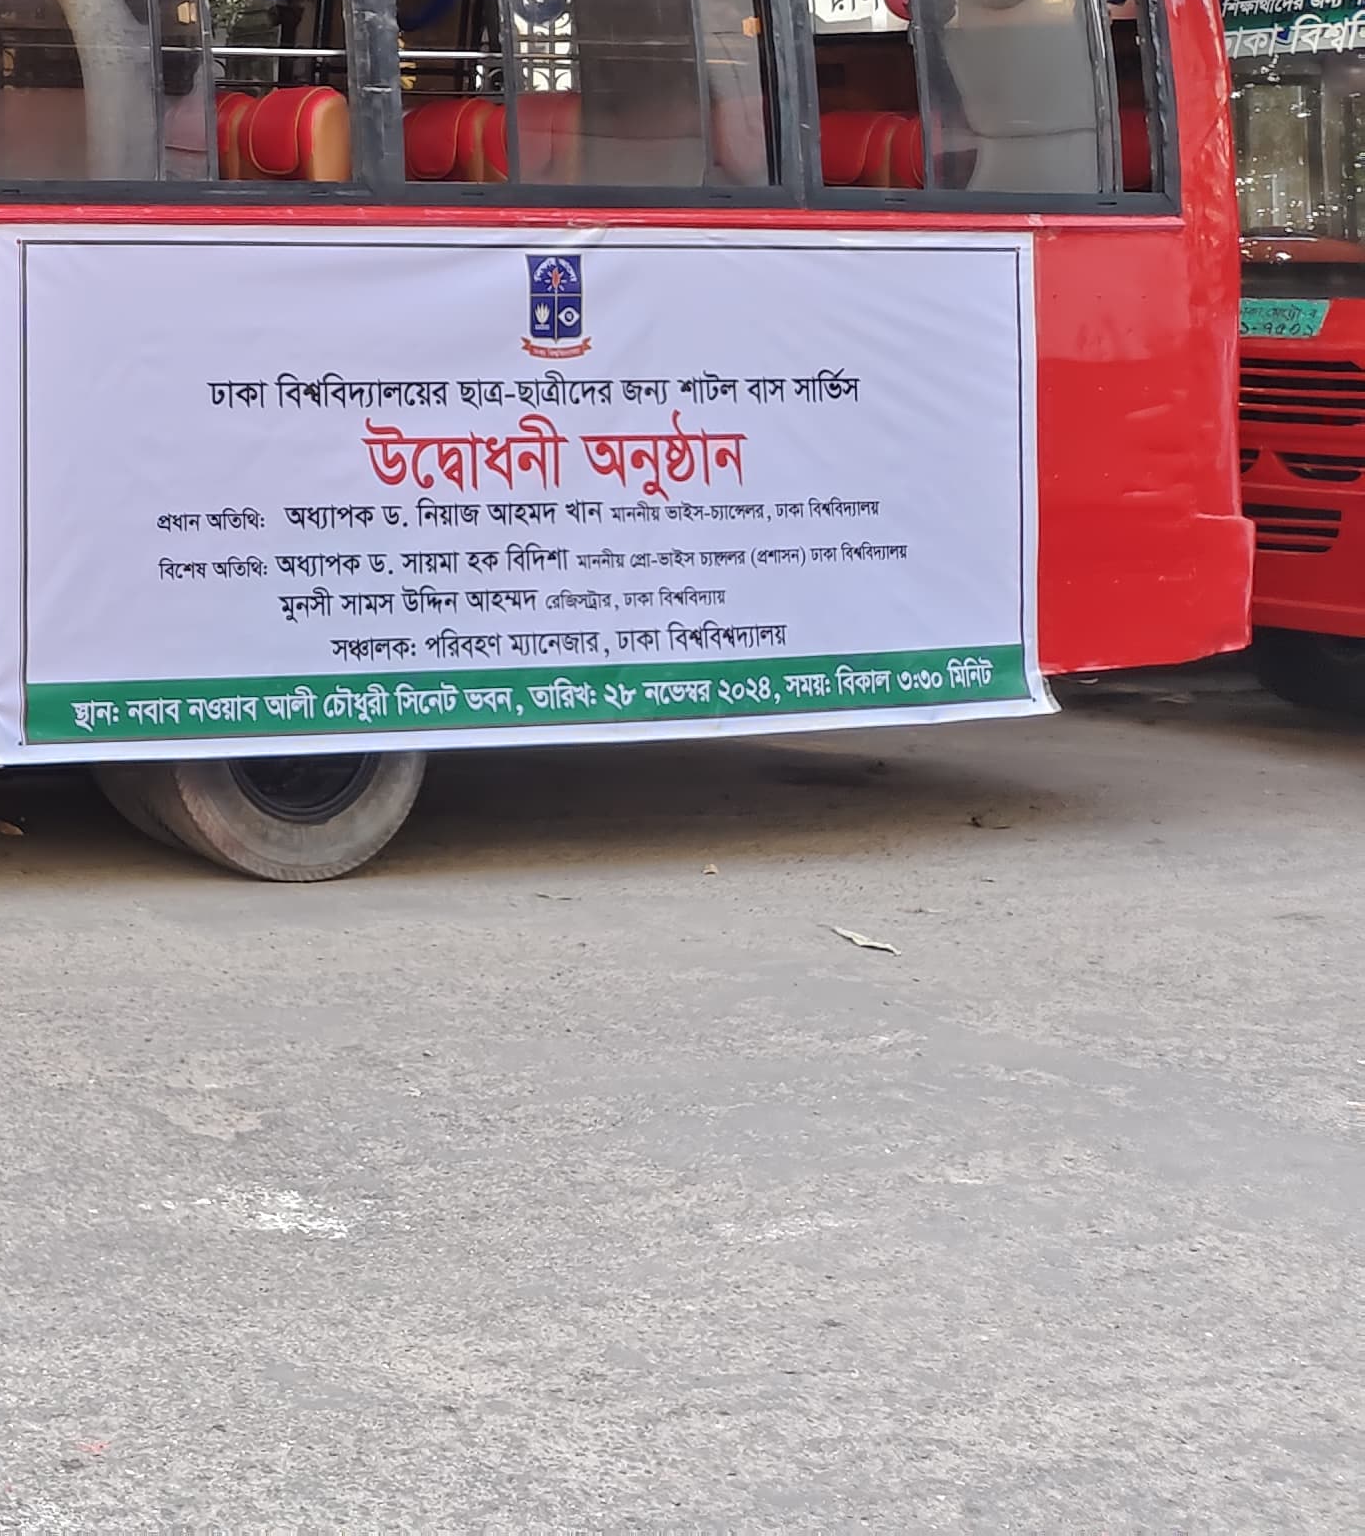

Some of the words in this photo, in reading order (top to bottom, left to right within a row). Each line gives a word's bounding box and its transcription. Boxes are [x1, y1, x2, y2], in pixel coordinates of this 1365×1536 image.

[1224, 23, 1285, 59] াকা
[207, 378, 269, 409] ঢাকা
[275, 372, 450, 409] বিশ্ববিদ্যালয়ের
[457, 370, 614, 410] ছাত্র-ছাত্রীদের
[620, 377, 670, 405] জন্য
[678, 370, 738, 405] শাটল
[747, 376, 785, 403] বাস
[794, 368, 860, 404] সার্ভিস
[361, 413, 569, 492] উদ্বোধনী
[579, 410, 748, 501] অনুষ্ঠান
[156, 511, 201, 532] প্রধান
[284, 504, 375, 530] অধ্যাপক
[381, 505, 409, 528] ড.
[416, 497, 481, 527] নিয়াজ
[487, 502, 559, 526] আহমদ
[565, 499, 604, 524] খান
[609, 500, 661, 523] মাননীয়
[775, 502, 805, 520] ঢাকা
[808, 496, 881, 519] বিশ্ববিদ্যালয়
[159, 556, 209, 581] বিশেষ
[275, 551, 362, 578] অধ্যাপক
[368, 553, 394, 576] ড.
[400, 550, 460, 575] সায়মা
[465, 550, 500, 574] হক
[505, 543, 570, 572] বিদিশা
[576, 548, 626, 570] মাননীয়
[810, 546, 838, 563] ঢাকা
[841, 541, 909, 562] বিশ্ববিদ্যালয়
[278, 586, 334, 624] মুনসী
[340, 591, 394, 616] সামস
[401, 585, 459, 615] উদ্দিন
[465, 588, 539, 613] আহম্মদ
[623, 591, 654, 608] ঢাকা
[425, 628, 502, 659] পরিবহণ
[615, 628, 661, 652] ঢাকা
[126, 697, 182, 726] নবাব
[188, 694, 257, 723] নওয়াব
[264, 684, 316, 720] আলী
[322, 683, 388, 722] চৌধুরী
[394, 681, 458, 716] সিনেট
[603, 683, 637, 710] ২৮
[643, 679, 711, 705] নভেম্বর
[835, 664, 891, 696] বিকাল
[947, 657, 994, 689] মিনিট
